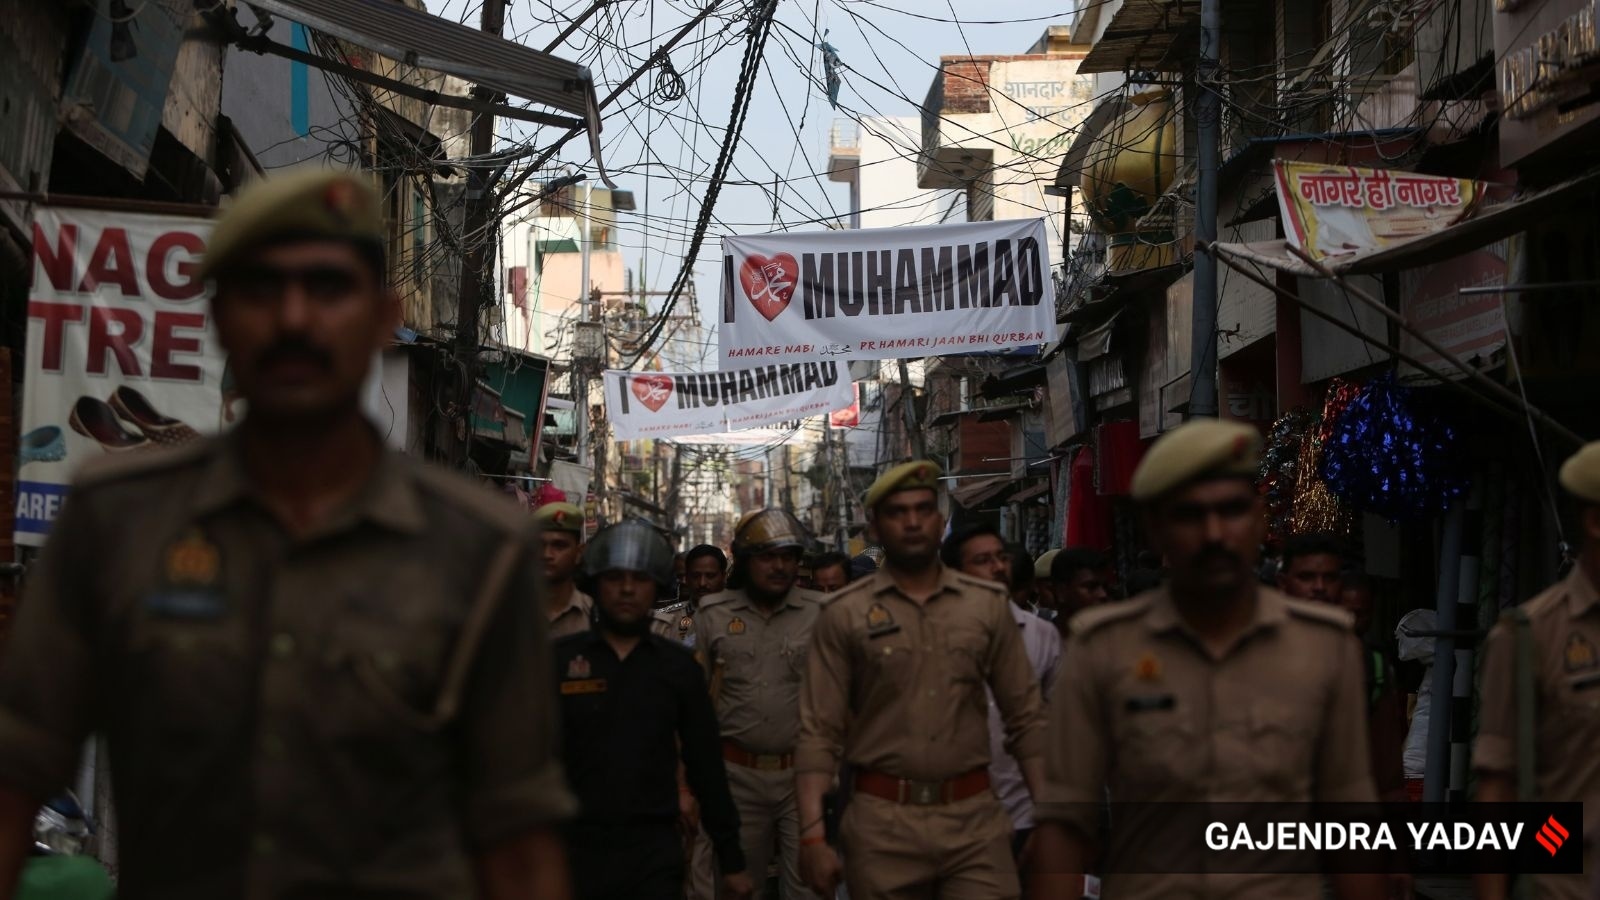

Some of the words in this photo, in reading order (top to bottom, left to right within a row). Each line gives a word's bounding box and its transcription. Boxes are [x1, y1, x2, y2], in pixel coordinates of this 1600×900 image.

[1299, 166, 1361, 205] नागरे
[1365, 168, 1392, 208] ही
[724, 255, 735, 323] I
[802, 237, 1044, 320] MUHAMMAD
[28, 301, 206, 381] TRE
[728, 346, 781, 357] HAMARE
[785, 344, 815, 353] NABI
[860, 341, 876, 350] PR
[879, 338, 930, 349] HAMARI
[932, 335, 966, 348] JAAN
[969, 334, 989, 344] BHI
[992, 331, 1044, 345] QURBAN
[619, 376, 630, 414] I
[675, 360, 838, 410] MUHAMMAD
[16, 491, 66, 520] ARE
